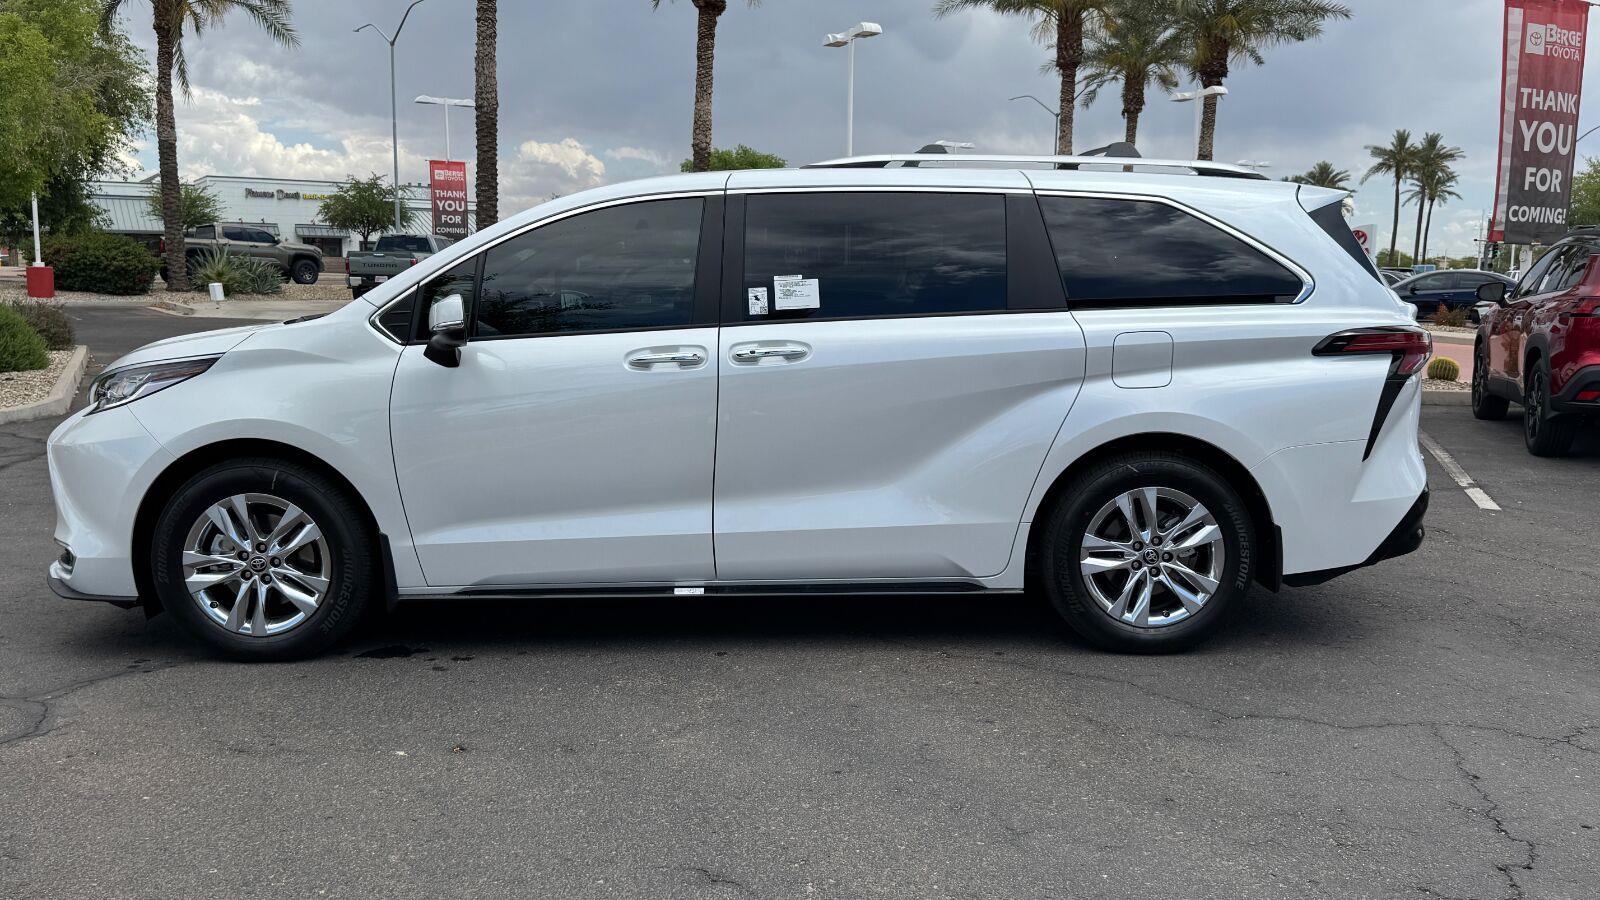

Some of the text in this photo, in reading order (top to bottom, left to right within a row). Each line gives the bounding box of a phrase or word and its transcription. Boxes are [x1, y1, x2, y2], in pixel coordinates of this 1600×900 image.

[1546, 24, 1582, 46] BERGE
[1546, 45, 1580, 61] TOYOTA
[1520, 87, 1578, 114] THANK
[1519, 119, 1573, 156] YOU
[1524, 166, 1562, 193] FOR
[434, 189, 466, 199] THANK
[436, 200, 465, 212] YOU
[1508, 205, 1567, 225] COMING!
[441, 214, 462, 224] FOR
[435, 226, 468, 235] COMING!
